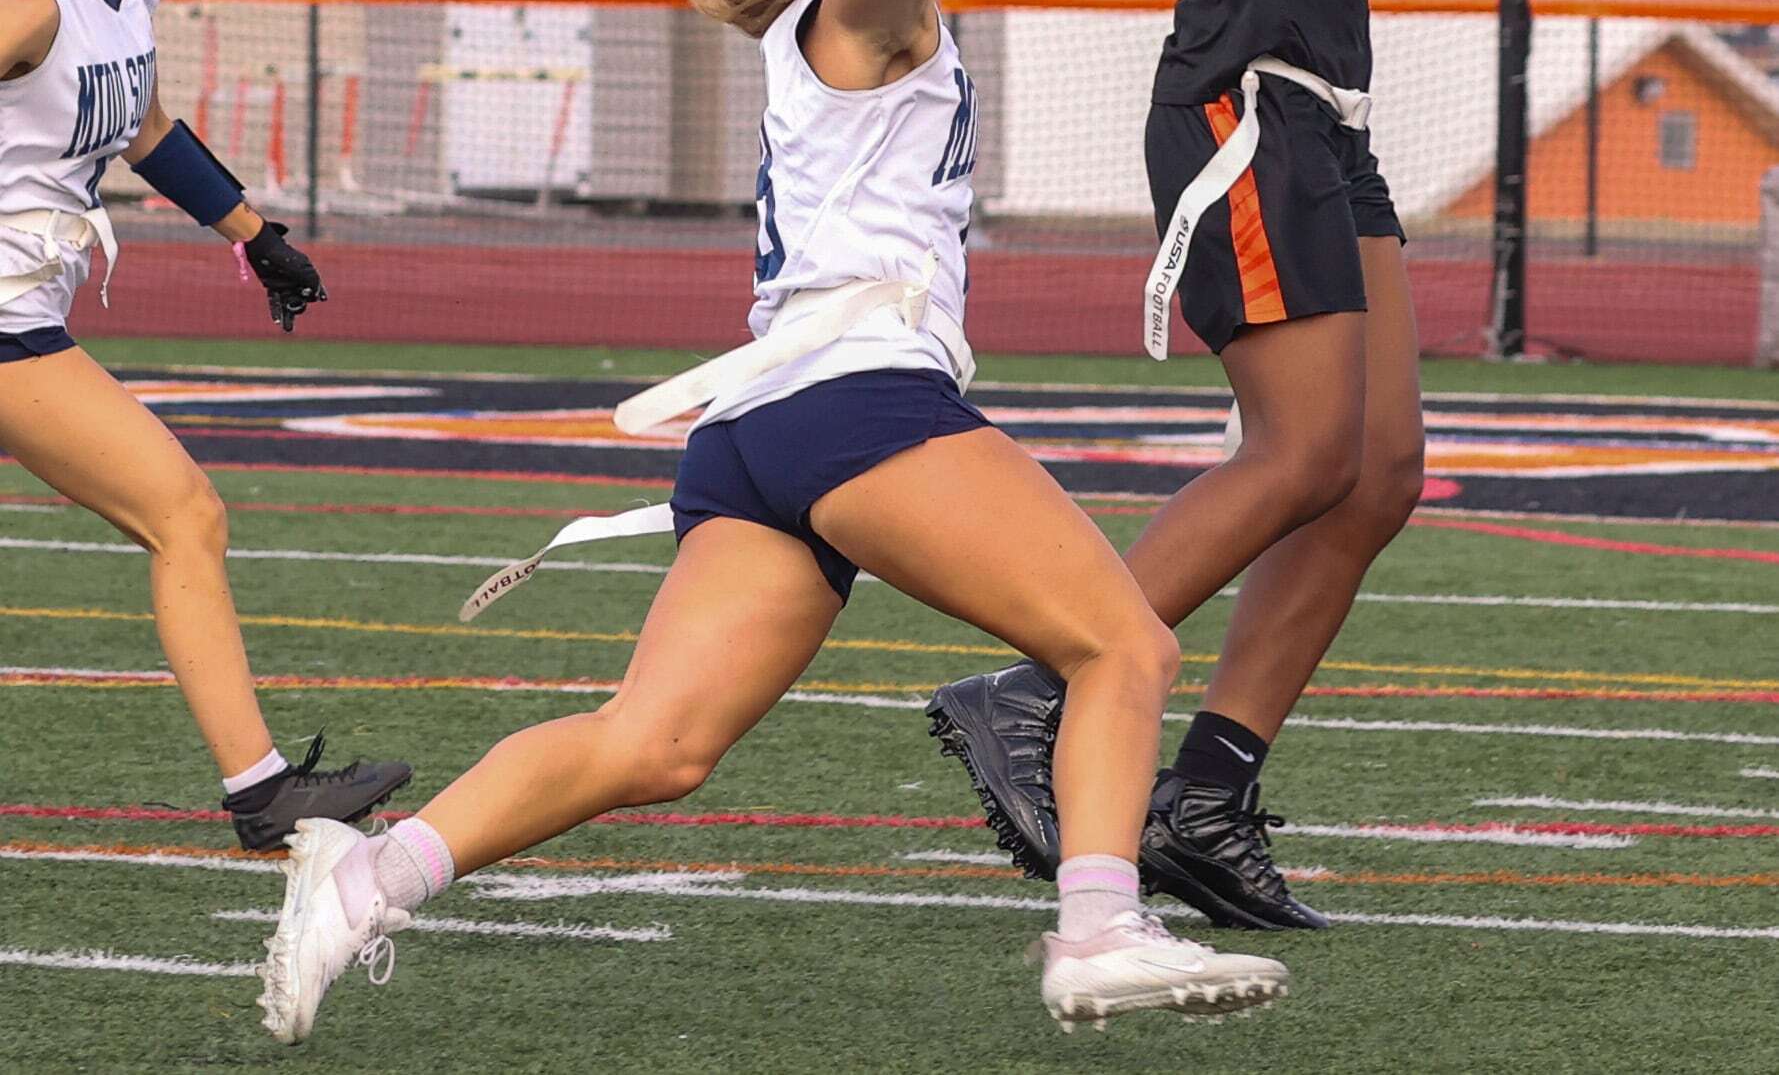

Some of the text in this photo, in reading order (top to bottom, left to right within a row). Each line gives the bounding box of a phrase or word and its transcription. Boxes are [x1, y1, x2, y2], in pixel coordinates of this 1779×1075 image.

[1151, 232, 1187, 347] USA FOOTBALL
[471, 555, 544, 608] OTBALL
